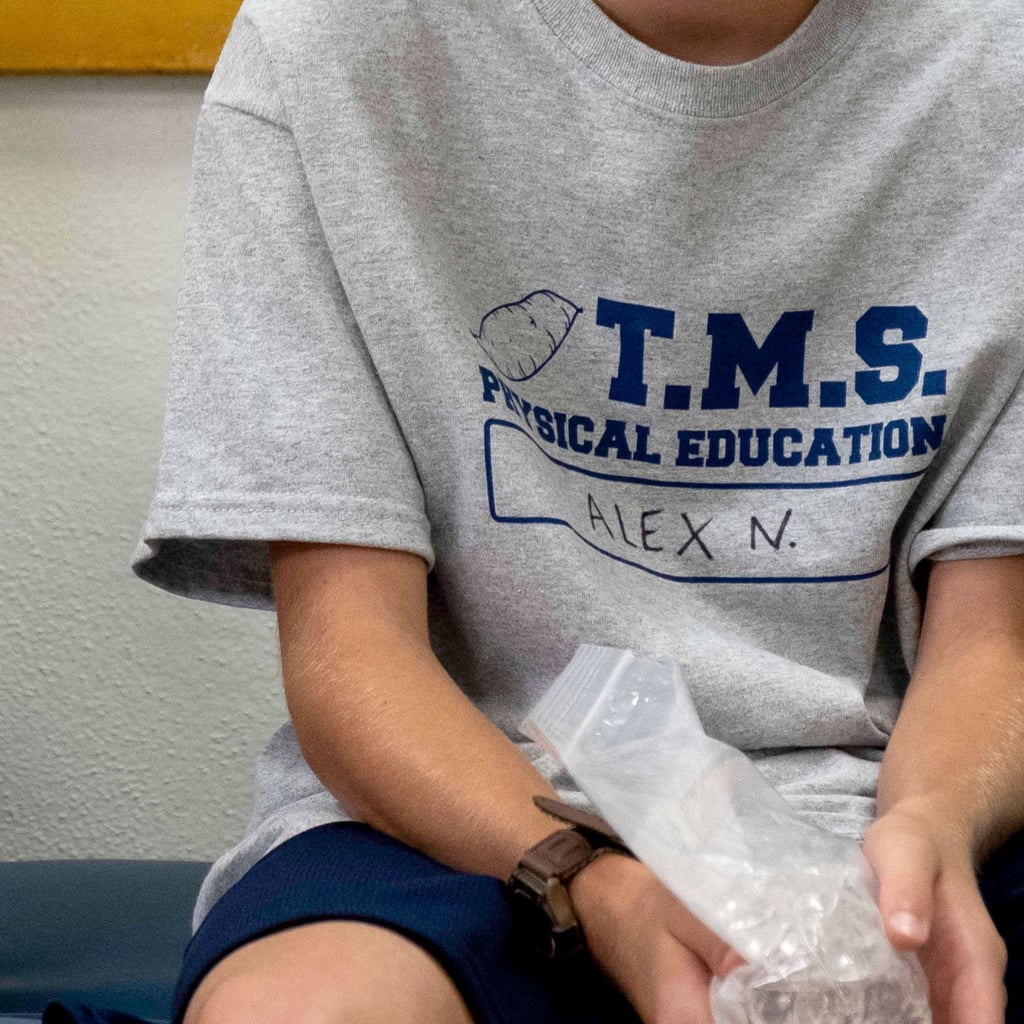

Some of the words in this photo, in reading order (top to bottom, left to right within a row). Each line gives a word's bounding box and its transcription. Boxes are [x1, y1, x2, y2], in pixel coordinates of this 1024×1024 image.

[596, 297, 947, 410] T.M.S.
[479, 365, 661, 464] PHYSICAL
[676, 415, 947, 467] EDUCATION
[588, 493, 714, 560] ALEX
[750, 510, 797, 550] N.
